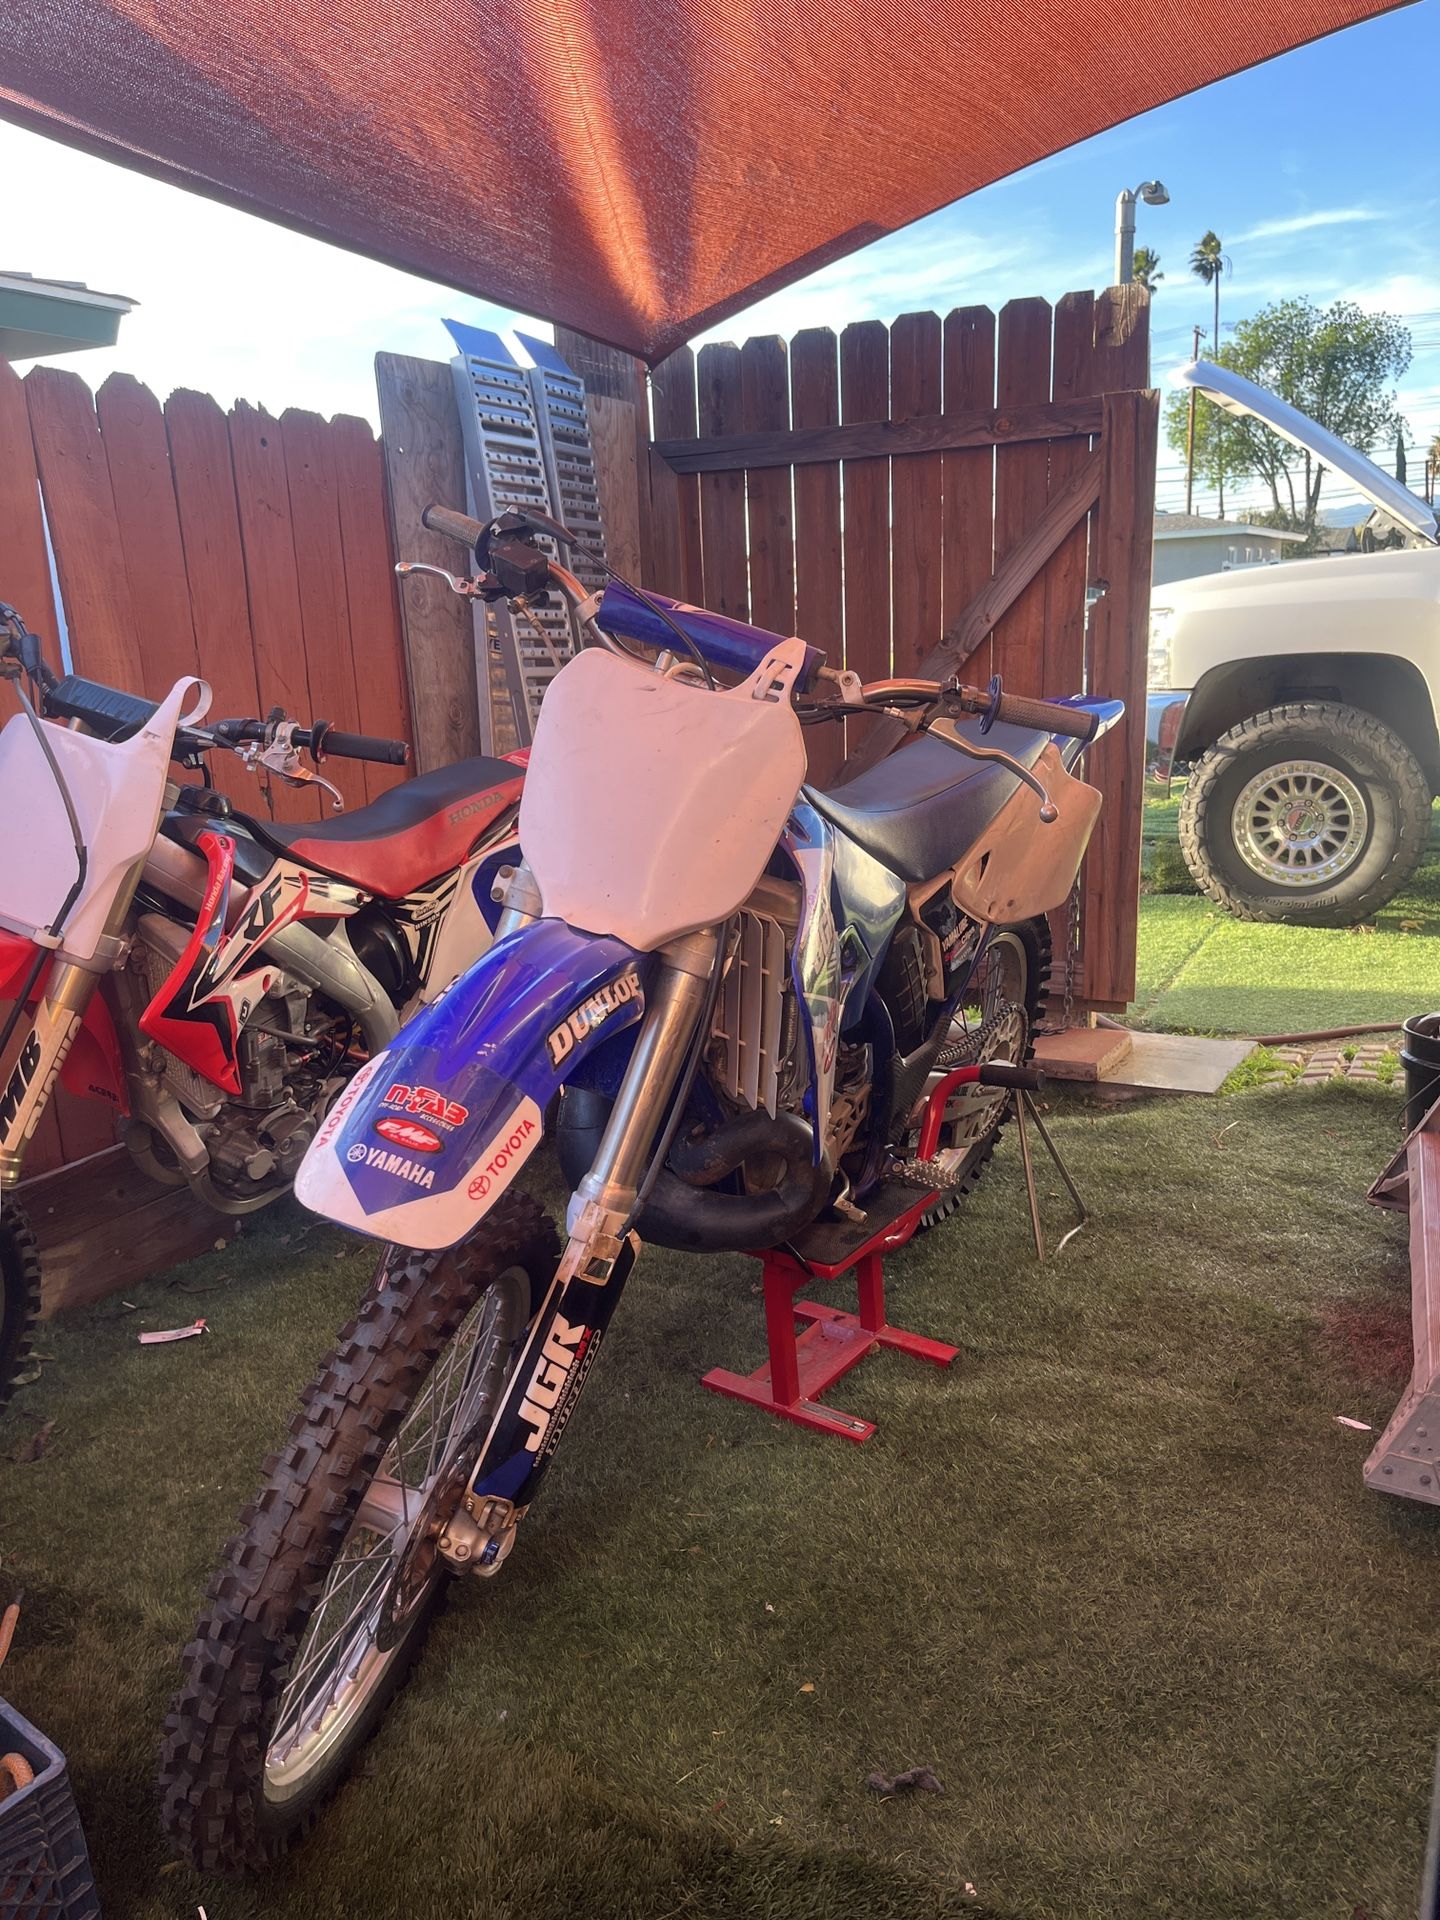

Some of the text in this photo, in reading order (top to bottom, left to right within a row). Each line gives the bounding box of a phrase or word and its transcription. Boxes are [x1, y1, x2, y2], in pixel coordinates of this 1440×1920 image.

[447, 791, 505, 827] HONDA
[204, 853, 232, 912] Honda Racing
[548, 973, 640, 1065] DUNLOP
[316, 1087, 360, 1148] TOYOTA
[377, 1121, 440, 1145] FMF
[365, 1147, 436, 1190] YAMAHA
[486, 1119, 535, 1177] TOYOTA
[518, 1311, 586, 1453] JGR
[547, 1328, 602, 1457] DUNLOP
